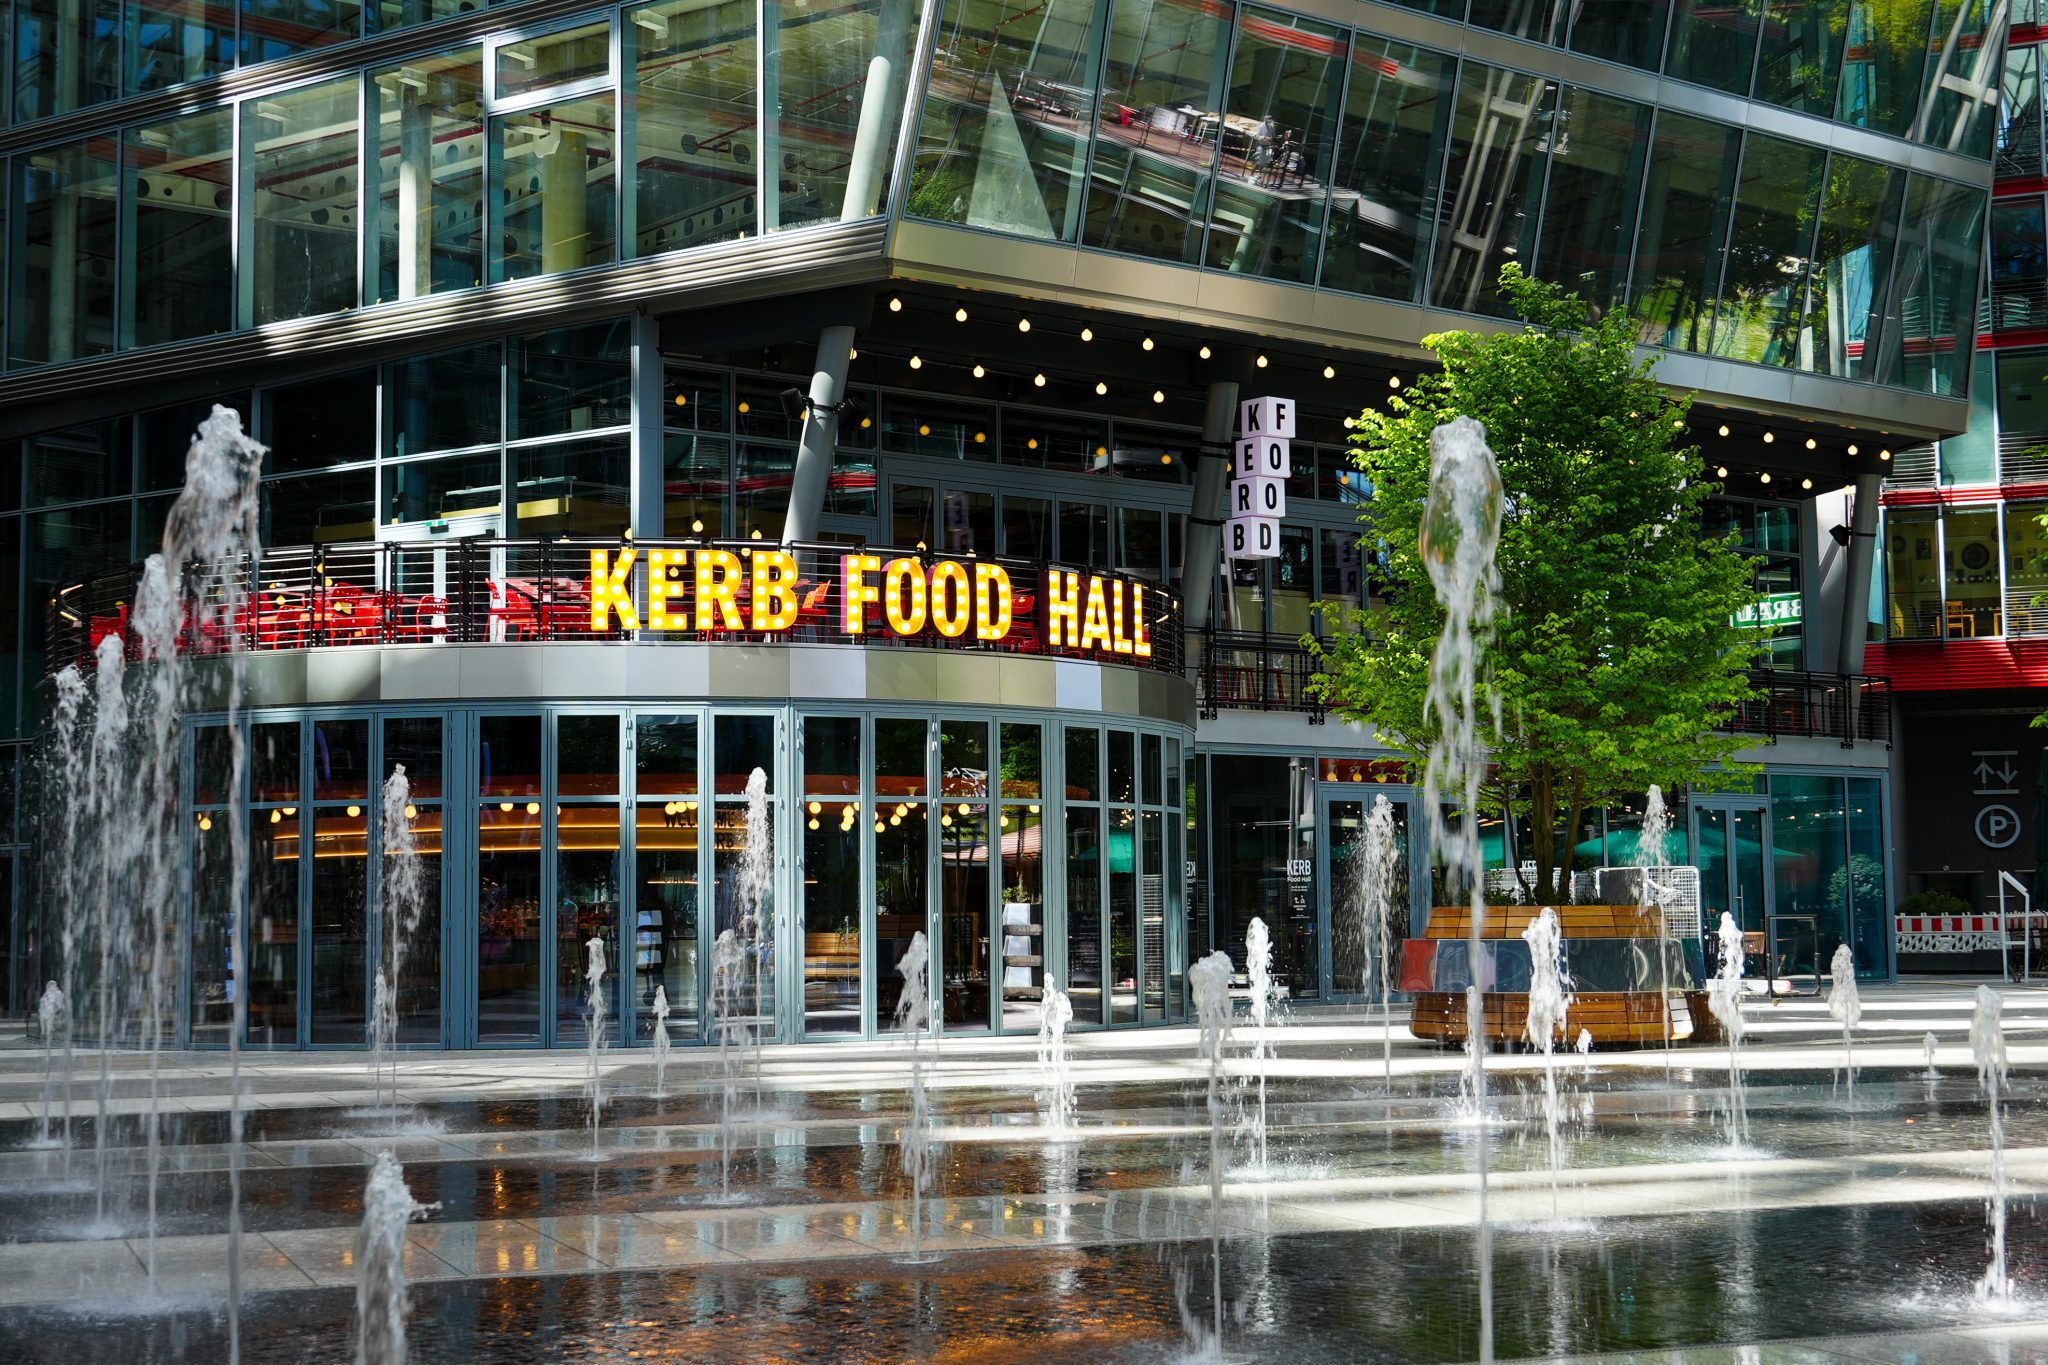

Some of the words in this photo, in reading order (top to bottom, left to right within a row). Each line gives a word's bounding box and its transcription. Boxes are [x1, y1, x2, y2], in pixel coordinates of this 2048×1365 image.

[1233, 403, 1261, 552] KERB
[1259, 403, 1286, 551] FOOD
[590, 549, 798, 631] KERB
[843, 555, 1012, 641] FOOD
[1048, 570, 1151, 657] HALL
[1286, 859, 1312, 876] KERB
[1989, 815, 2008, 837] P
